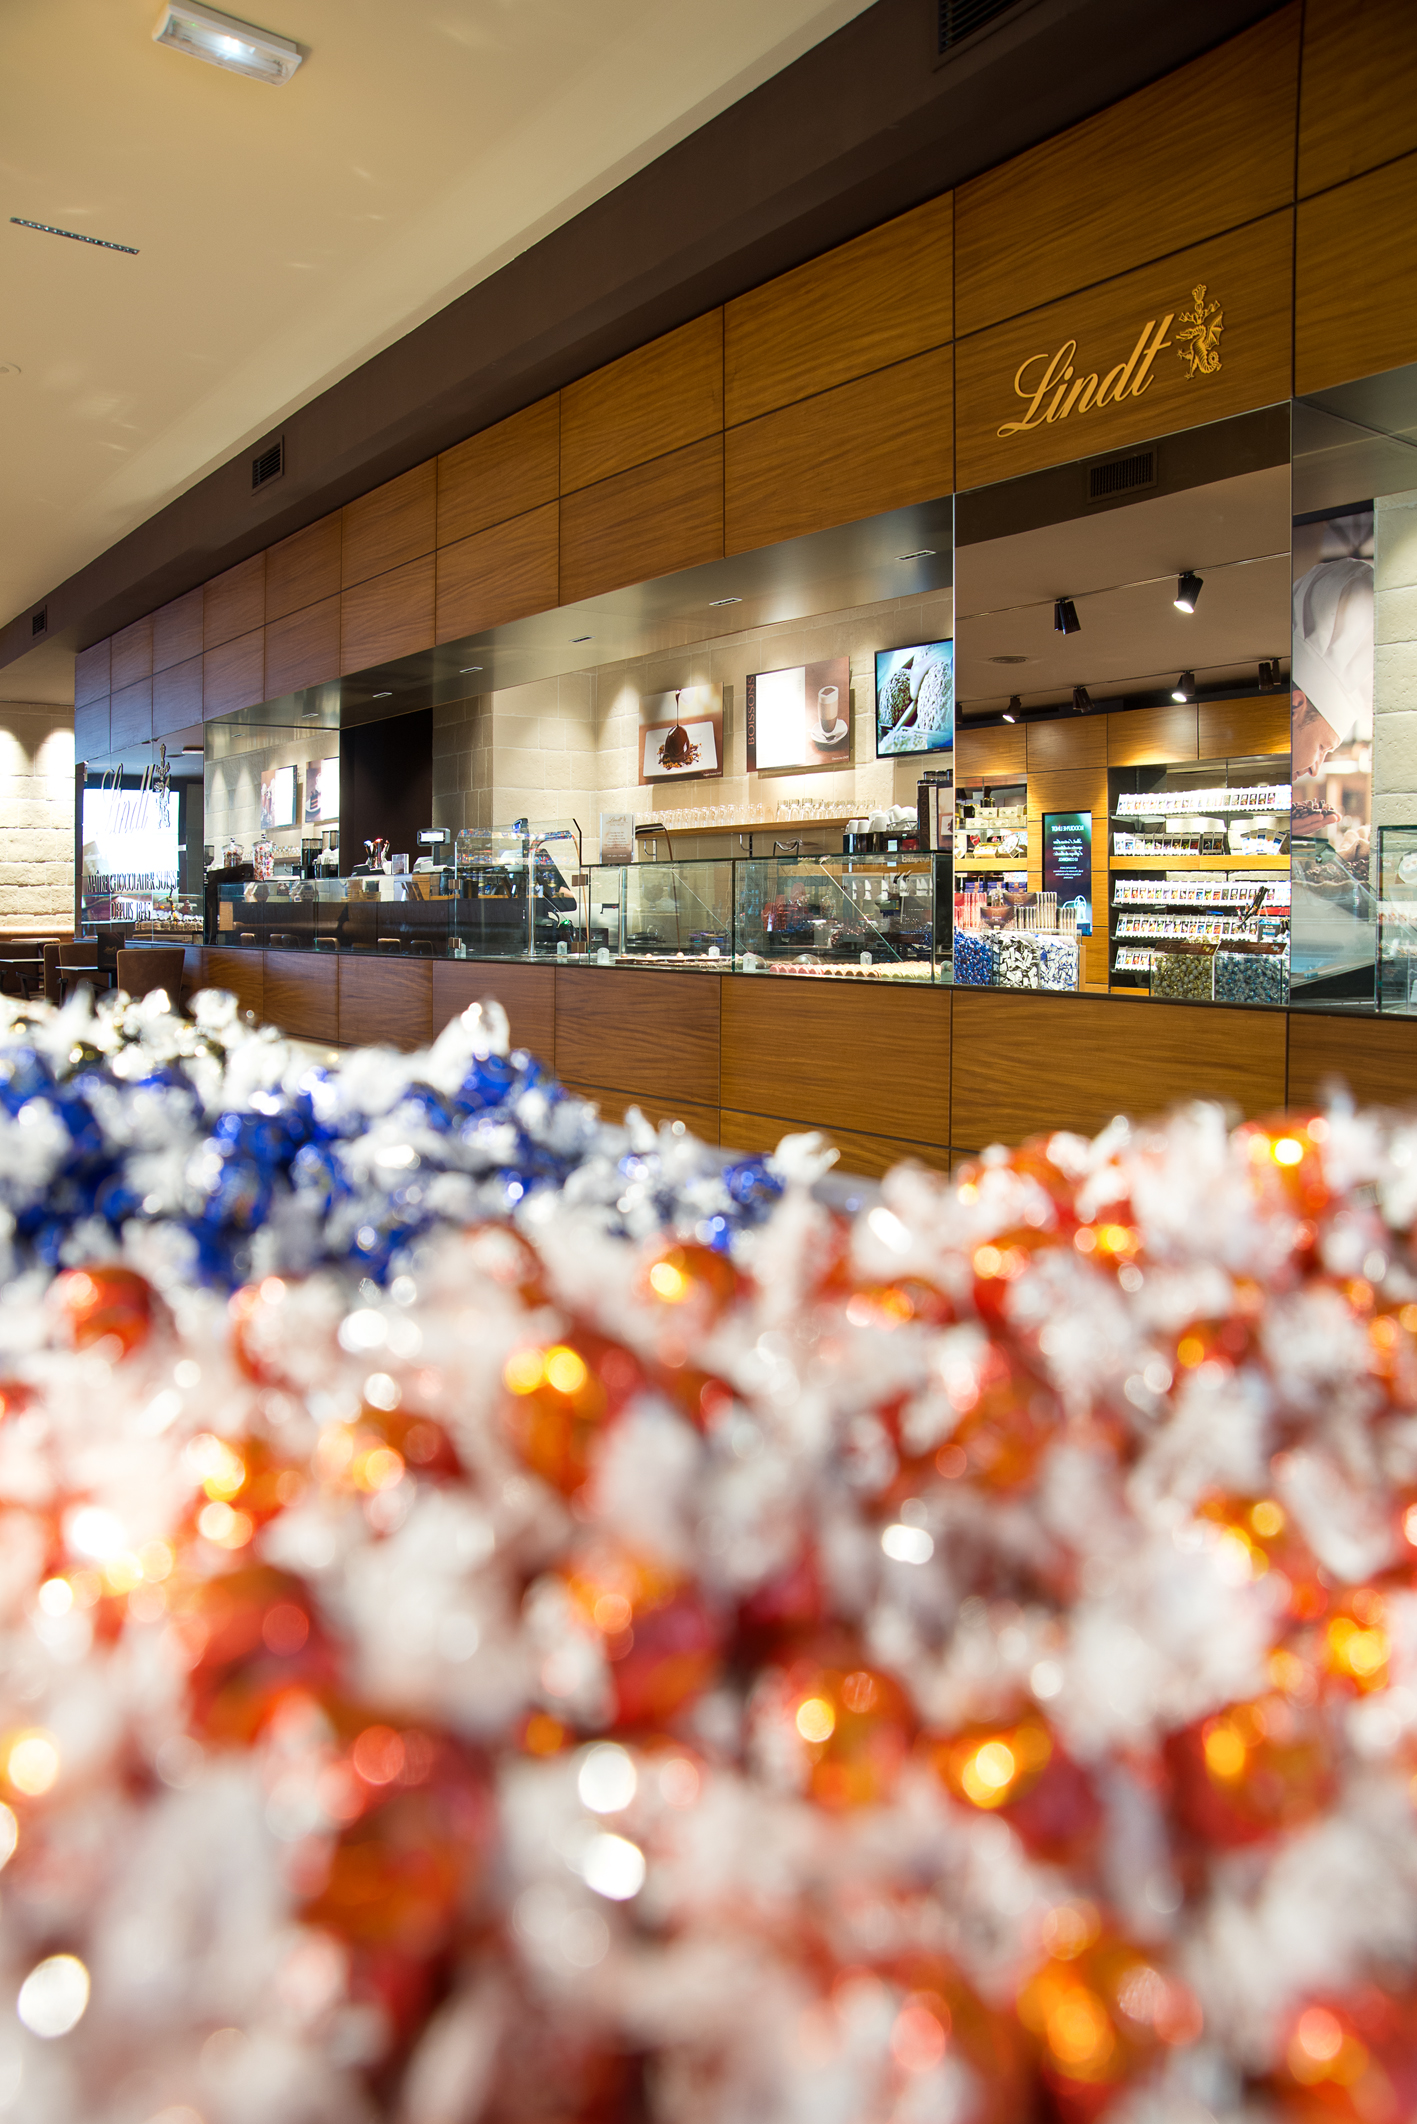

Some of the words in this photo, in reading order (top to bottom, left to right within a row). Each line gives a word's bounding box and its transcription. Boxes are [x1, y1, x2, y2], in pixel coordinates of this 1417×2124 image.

[997, 313, 1175, 438] Lindt
[747, 676, 755, 745] BOISSONS
[921, 786, 929, 835] BOISSONS
[109, 872, 155, 892] CHOCOLATIER
[110, 902, 133, 920] DEPUIS
